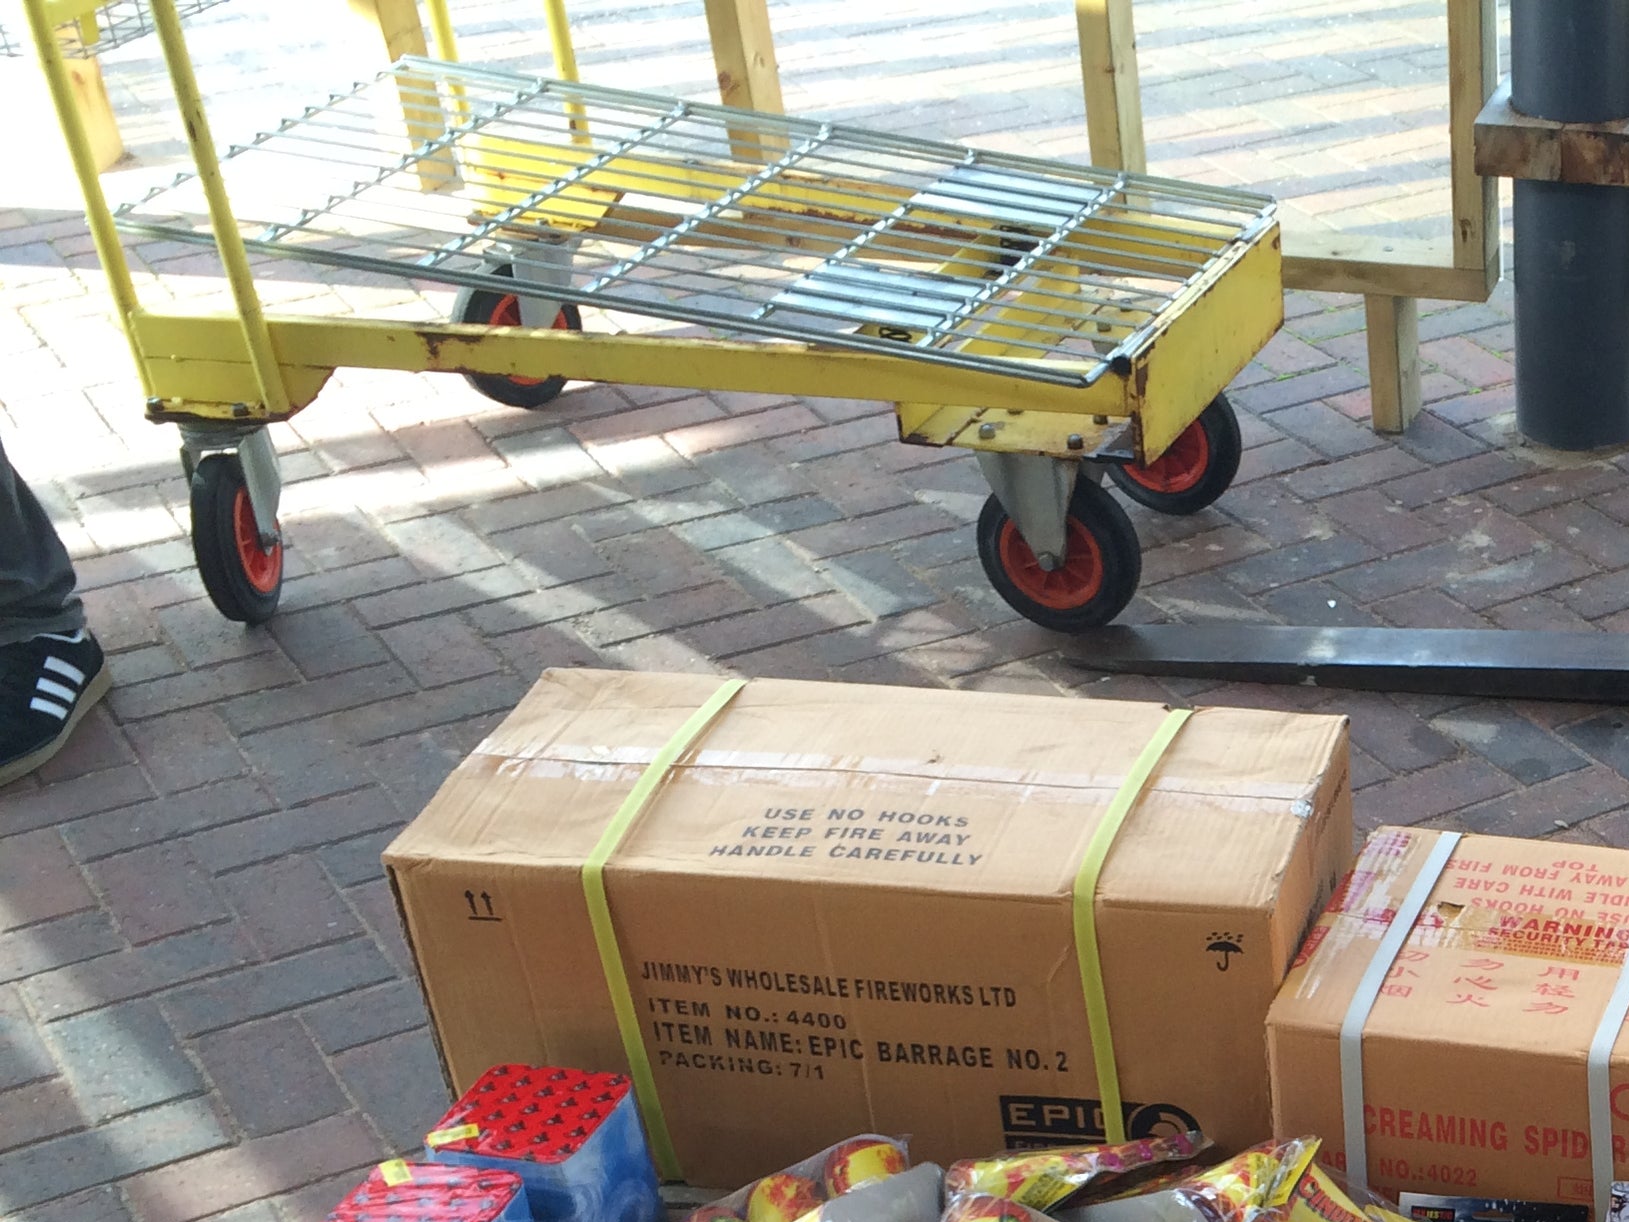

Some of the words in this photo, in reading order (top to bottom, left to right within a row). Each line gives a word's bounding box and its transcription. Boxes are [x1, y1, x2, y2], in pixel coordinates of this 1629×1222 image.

[764, 807, 815, 821] USE
[827, 808, 864, 821] NO
[878, 810, 970, 828] HOOKS
[742, 826, 813, 840] KEEP
[824, 827, 885, 841] FIRE
[897, 831, 971, 847] AWAY
[709, 845, 817, 858] HANDLE
[829, 846, 983, 866] CAREFULLY
[1502, 865, 1560, 881] FROM
[1552, 860, 1599, 873] TOP
[1454, 877, 1510, 893] CARE
[1571, 873, 1629, 887] AWAY
[1520, 885, 1573, 901] WITH
[1471, 897, 1545, 915] HOOKS
[1488, 927, 1589, 947] SECURITY
[641, 961, 722, 987] JIMMY'S
[727, 969, 849, 999] WHOLESALE
[854, 978, 974, 1005] FIREWORKS
[979, 986, 1017, 1008] LTD
[649, 998, 710, 1018] ITEM
[786, 1009, 847, 1030] 4400
[653, 1020, 712, 1047] ITEM
[726, 1028, 803, 1055] NAME:
[808, 1035, 865, 1061] EPIC
[877, 1040, 995, 1070] BARRAGE
[1006, 1047, 1050, 1072] NO.
[1055, 1050, 1069, 1072] 2
[658, 1050, 783, 1077] PACKING:
[790, 1063, 826, 1080] 7/1
[1363, 1104, 1508, 1151] CREAMING
